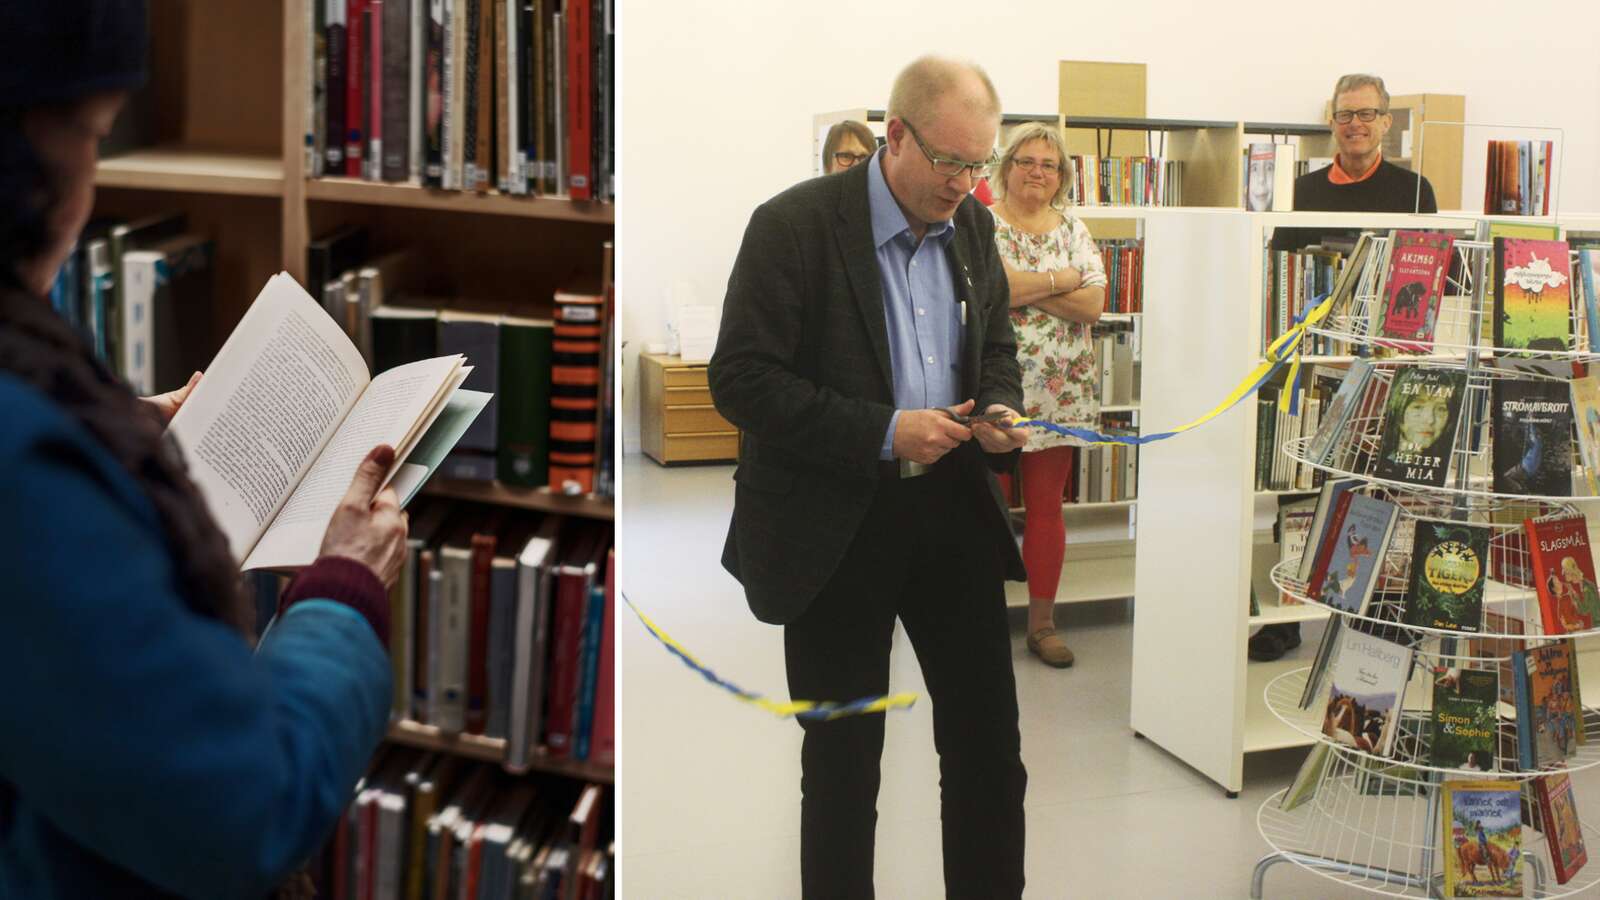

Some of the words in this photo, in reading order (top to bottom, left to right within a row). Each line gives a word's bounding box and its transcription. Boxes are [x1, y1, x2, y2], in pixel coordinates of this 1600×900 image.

[1401, 252, 1434, 265] AKIMBO
[1401, 382, 1420, 395] EN
[1502, 398, 1569, 413] STRÖMAVBROTT
[1394, 451, 1441, 468] HETER
[1405, 466, 1434, 480] MIA
[1540, 531, 1587, 552] SLAGSMÅL
[1439, 712, 1471, 725] Simon
[1443, 722, 1455, 734] &
[1455, 726, 1490, 738] Sophie
